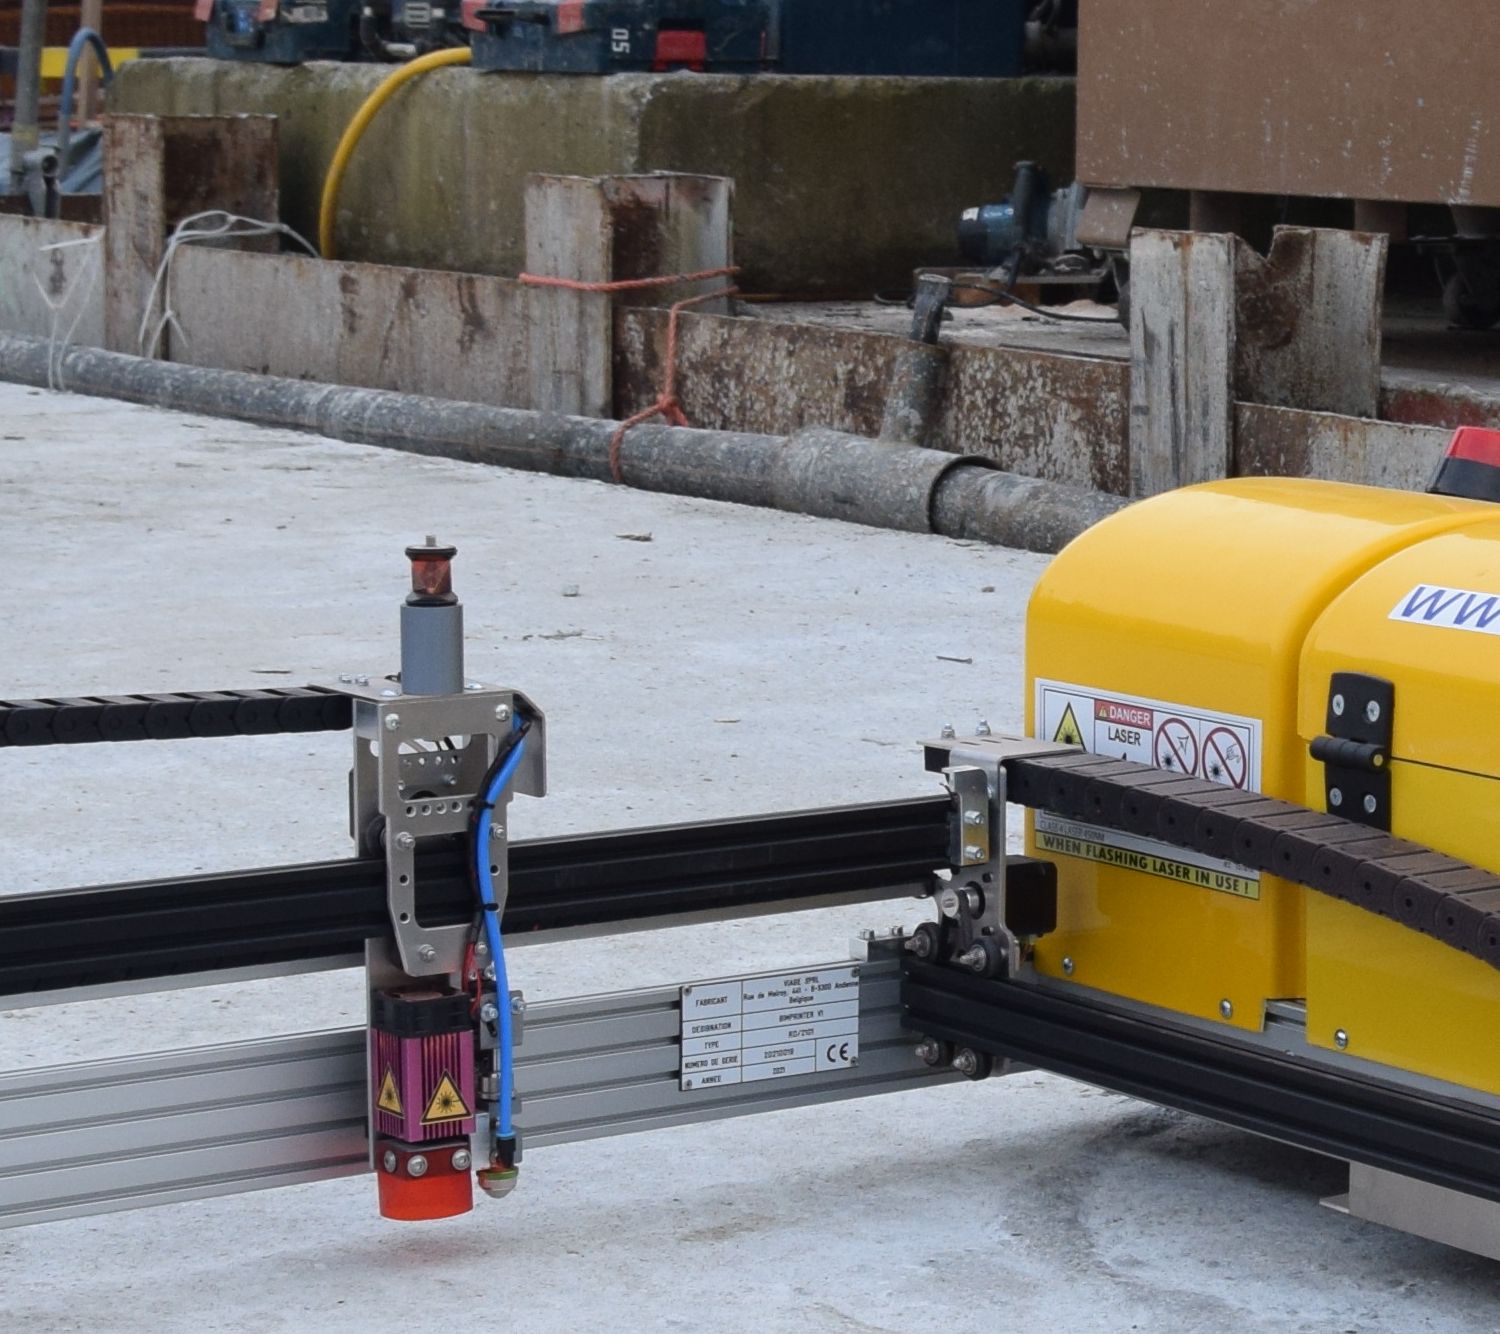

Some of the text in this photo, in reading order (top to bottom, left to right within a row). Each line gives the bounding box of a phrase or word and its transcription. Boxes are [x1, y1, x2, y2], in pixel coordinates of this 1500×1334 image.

[1109, 705, 1151, 725] DANGER
[1107, 726, 1141, 746] LASER
[1043, 834, 1082, 855] WHEN
[1086, 844, 1148, 870] FLASHING
[1152, 858, 1191, 880] LASER
[1195, 869, 1211, 884] IN
[1215, 875, 1240, 893] USE
[827, 1042, 849, 1063] CE
